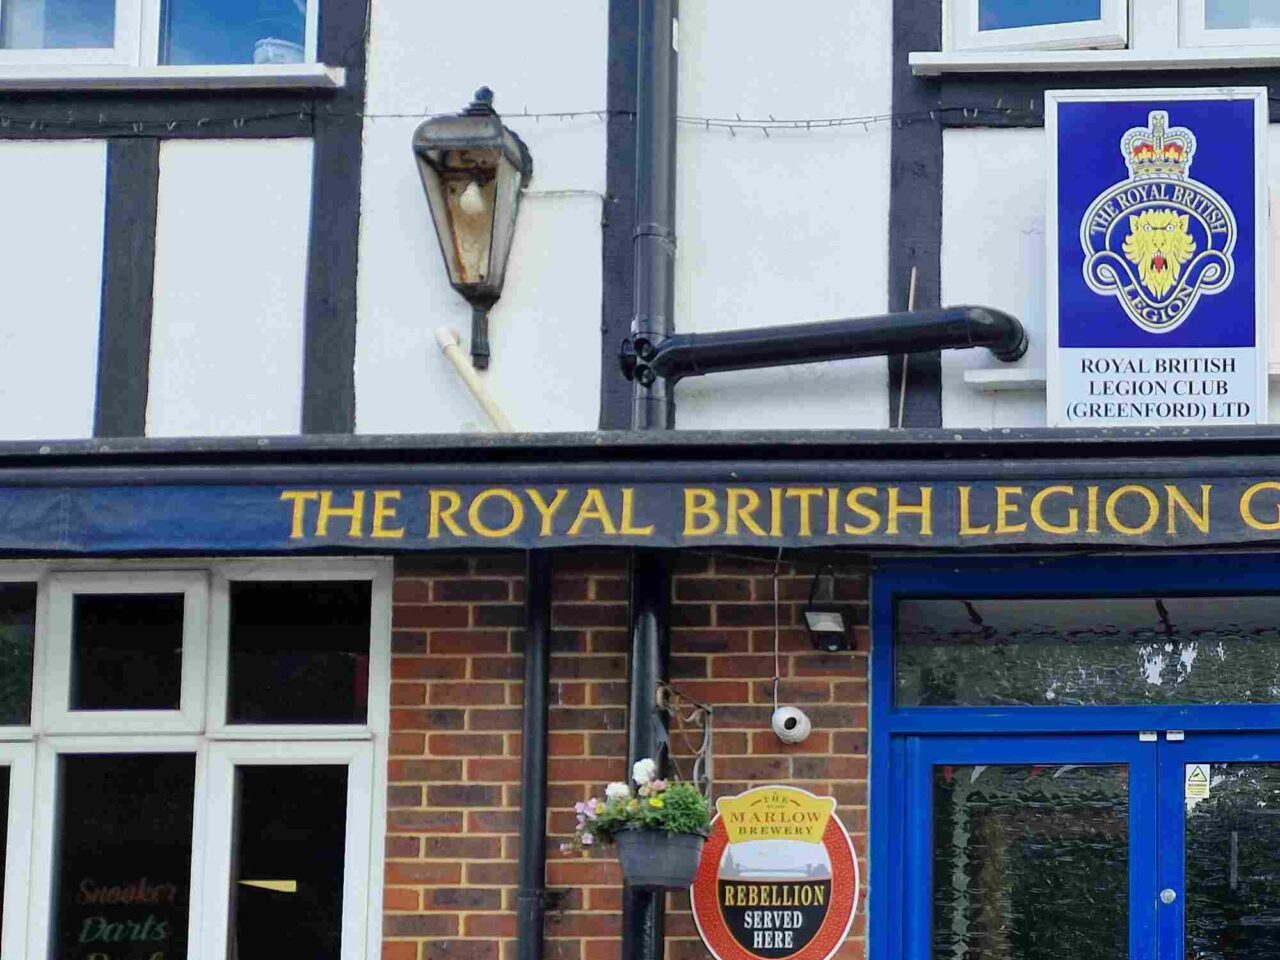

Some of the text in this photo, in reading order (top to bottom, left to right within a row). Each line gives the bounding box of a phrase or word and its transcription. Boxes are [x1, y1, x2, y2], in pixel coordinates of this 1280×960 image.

[1090, 183, 1228, 235] THE ROYAL BRITISH
[1121, 285, 1194, 323] LEGION
[1080, 358, 1236, 374] ROYAL BRITISH
[1089, 379, 1228, 396] LEGION CLUB
[1066, 401, 1251, 421] (GREENFORD) LTD
[280, 489, 405, 539] THE
[425, 487, 655, 538] ROYAL
[681, 485, 933, 537] BRITISH
[958, 484, 1213, 536] LEGION
[729, 811, 822, 824] MARLOW
[738, 826, 814, 836] BREWERY
[724, 885, 825, 907] REBELLION
[78, 914, 170, 943] Darts
[744, 911, 803, 929] SERVED
[753, 931, 794, 949] HERE
